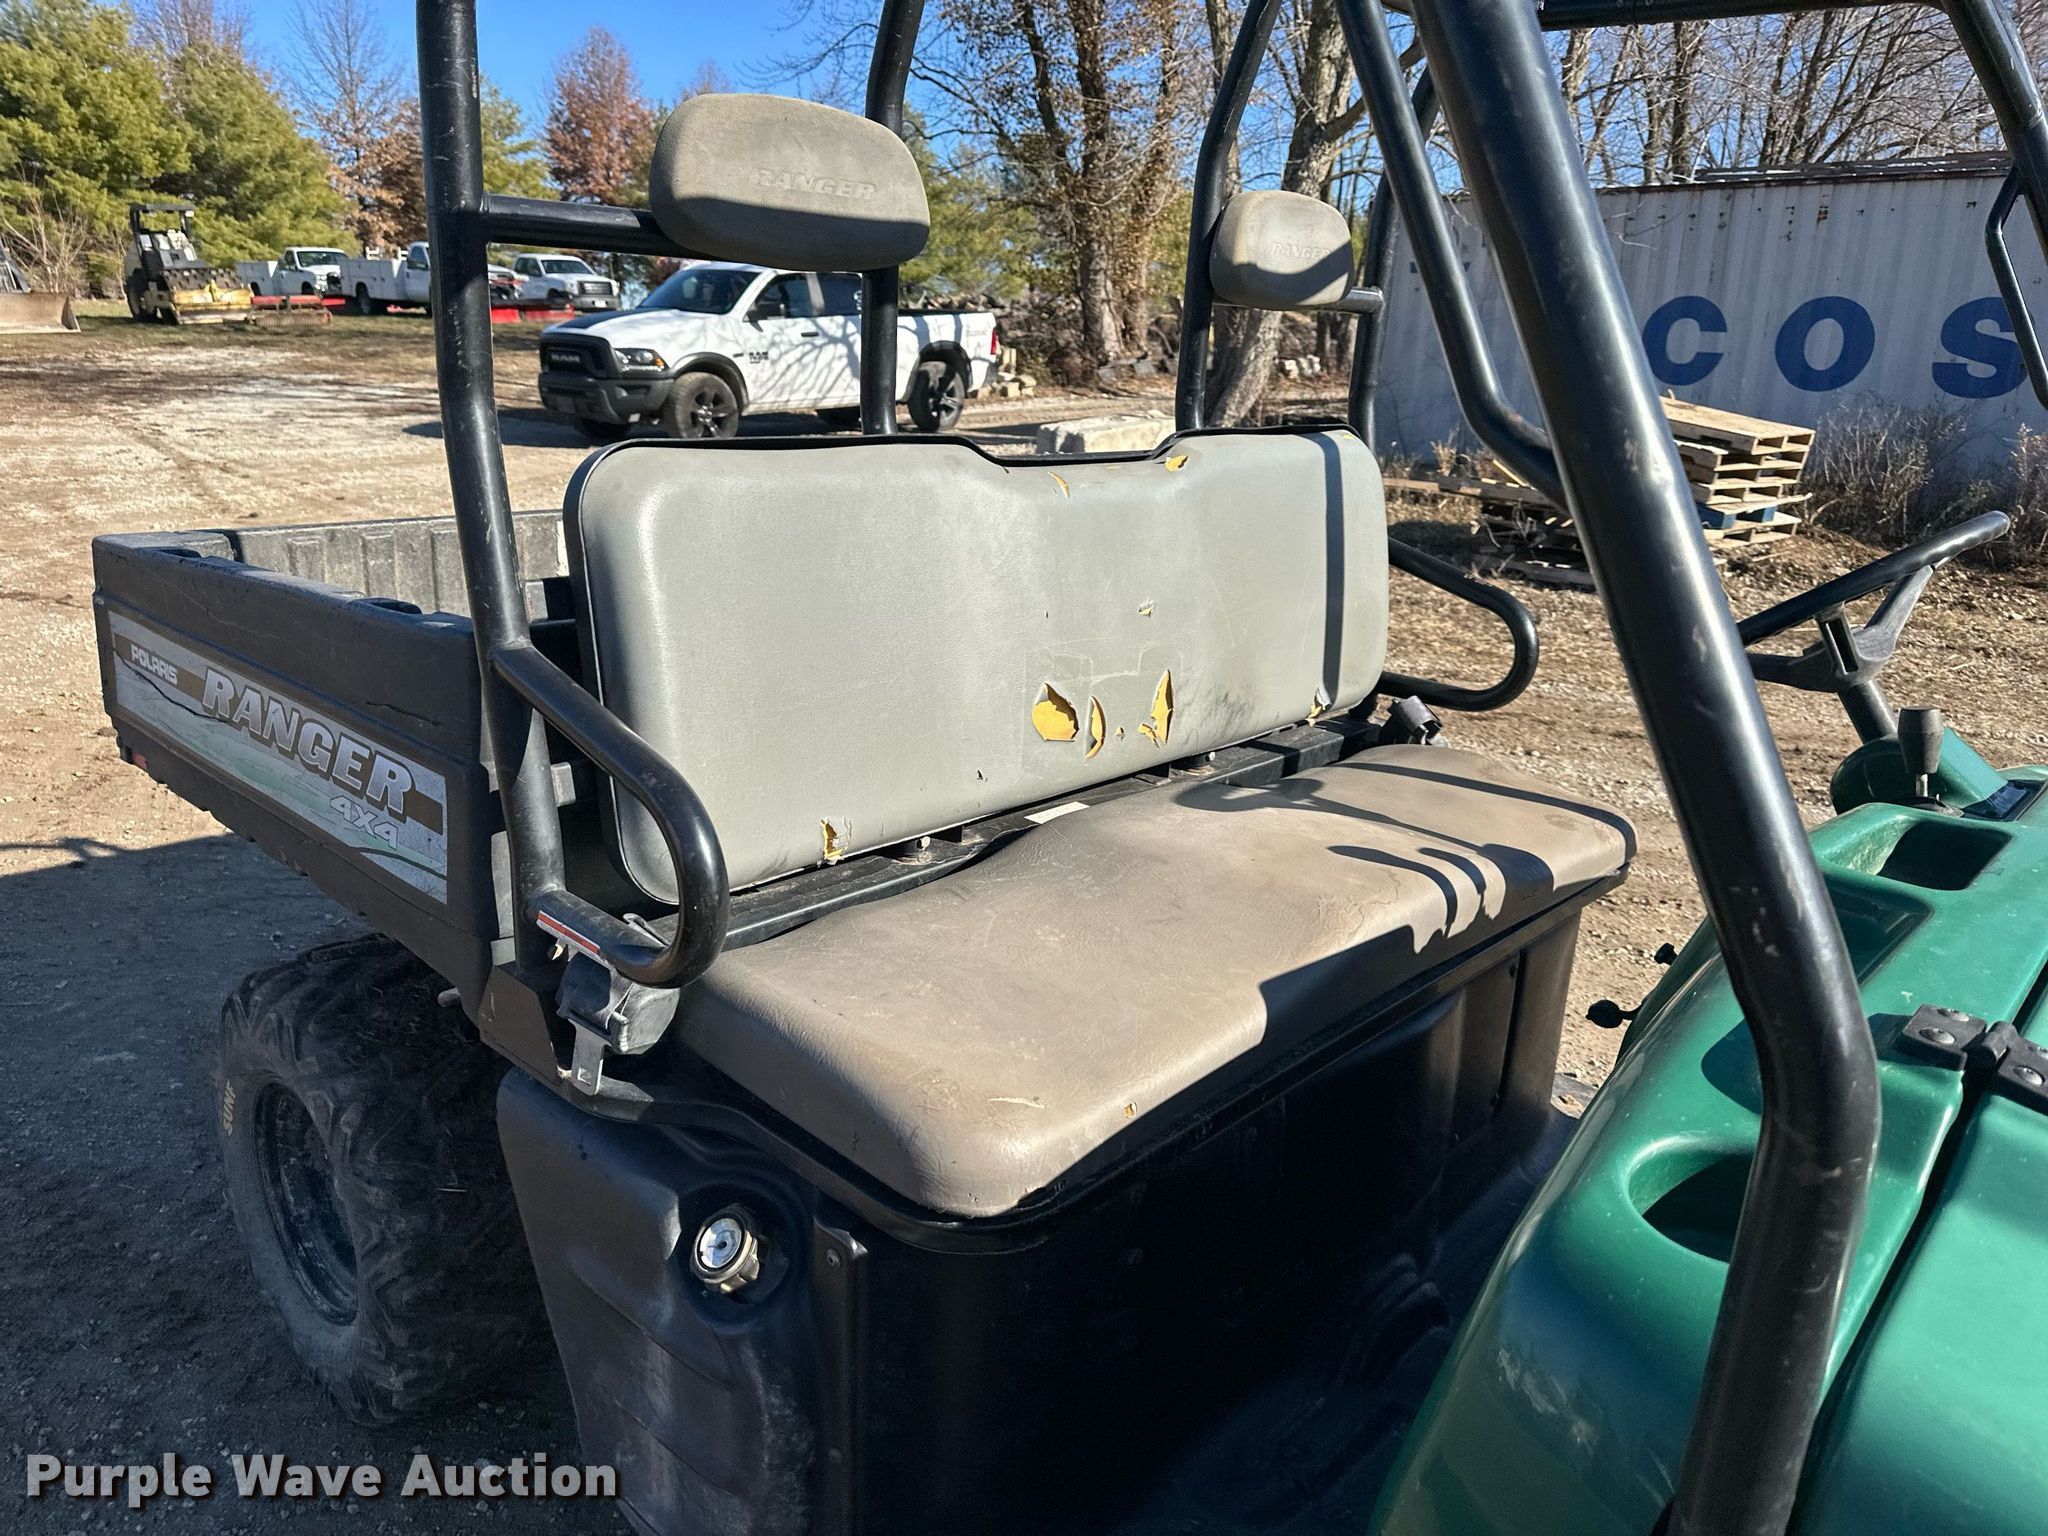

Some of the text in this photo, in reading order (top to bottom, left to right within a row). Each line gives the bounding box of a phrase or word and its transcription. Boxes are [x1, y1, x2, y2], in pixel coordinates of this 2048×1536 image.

[753, 167, 876, 201] RANGER
[130, 643, 177, 686] POLARIS
[202, 666, 414, 822] RANGER
